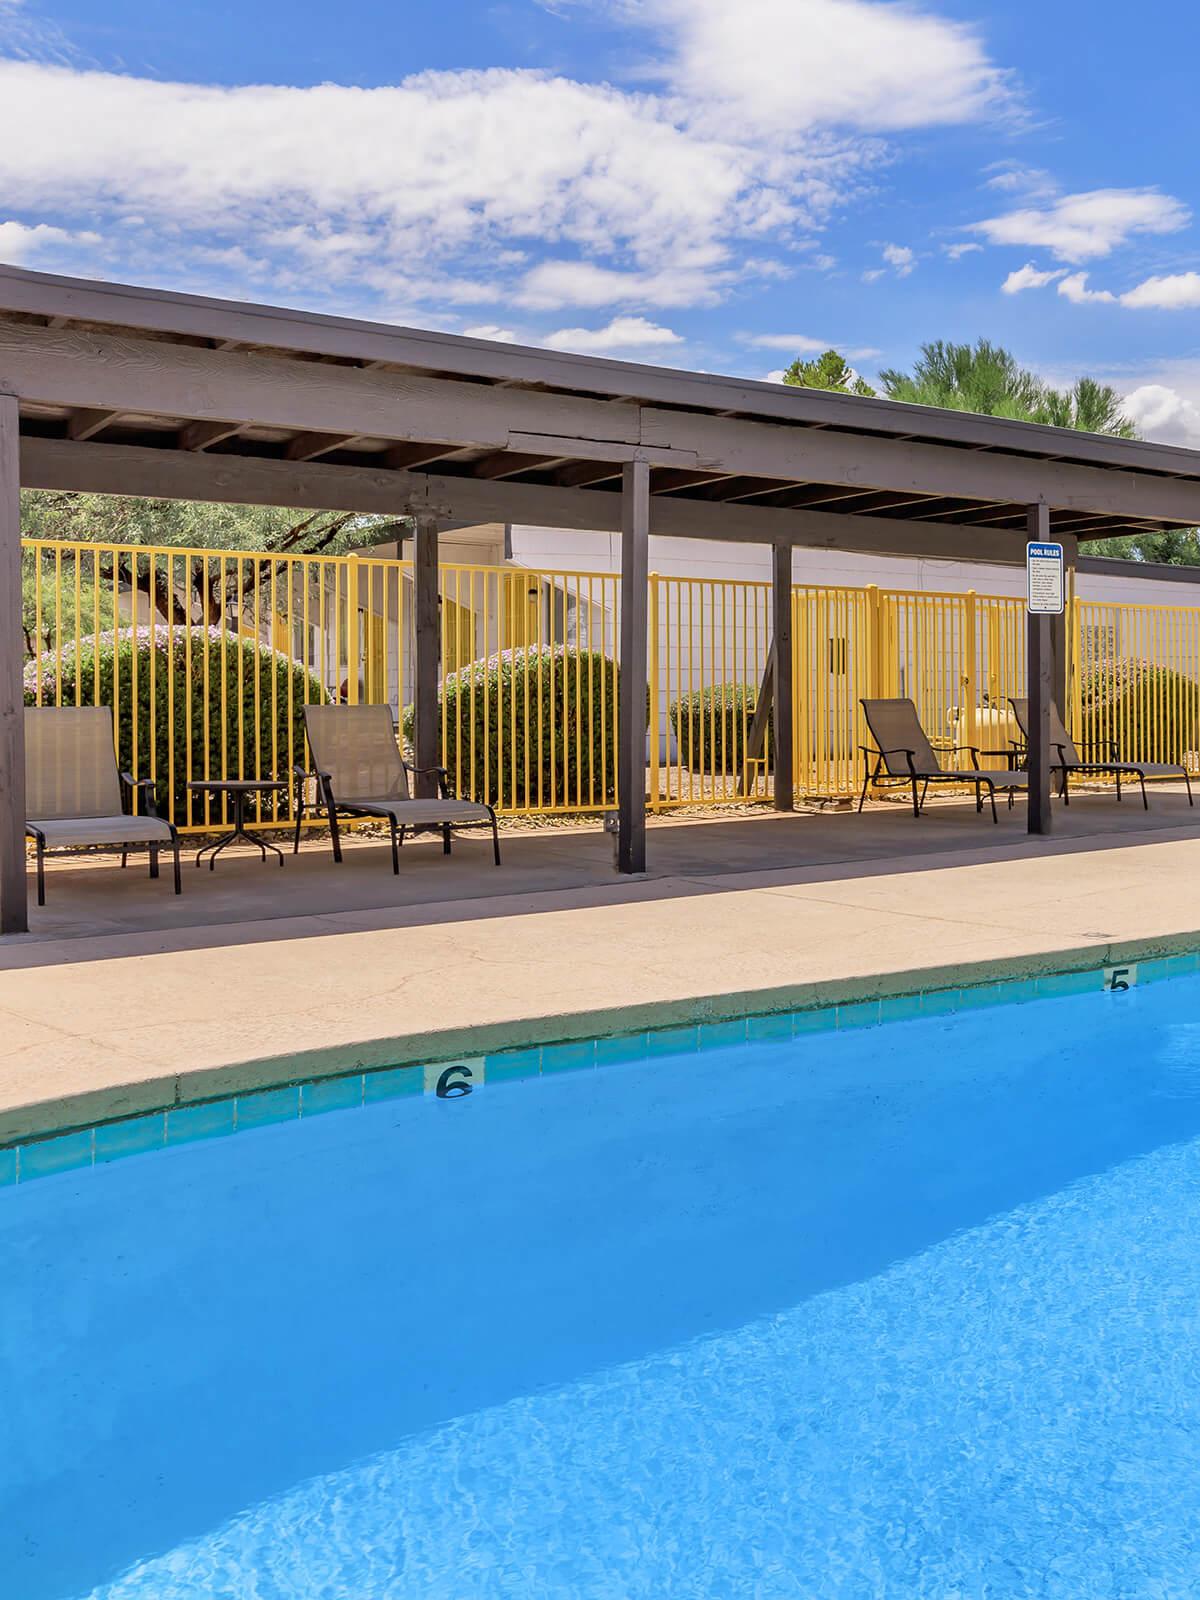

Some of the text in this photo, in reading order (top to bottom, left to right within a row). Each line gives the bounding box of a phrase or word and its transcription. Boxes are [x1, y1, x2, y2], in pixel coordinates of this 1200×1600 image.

[1030, 548, 1060, 557] POOL RULES
[1110, 969, 1129, 993] 5
[436, 1065, 473, 1099] 6
